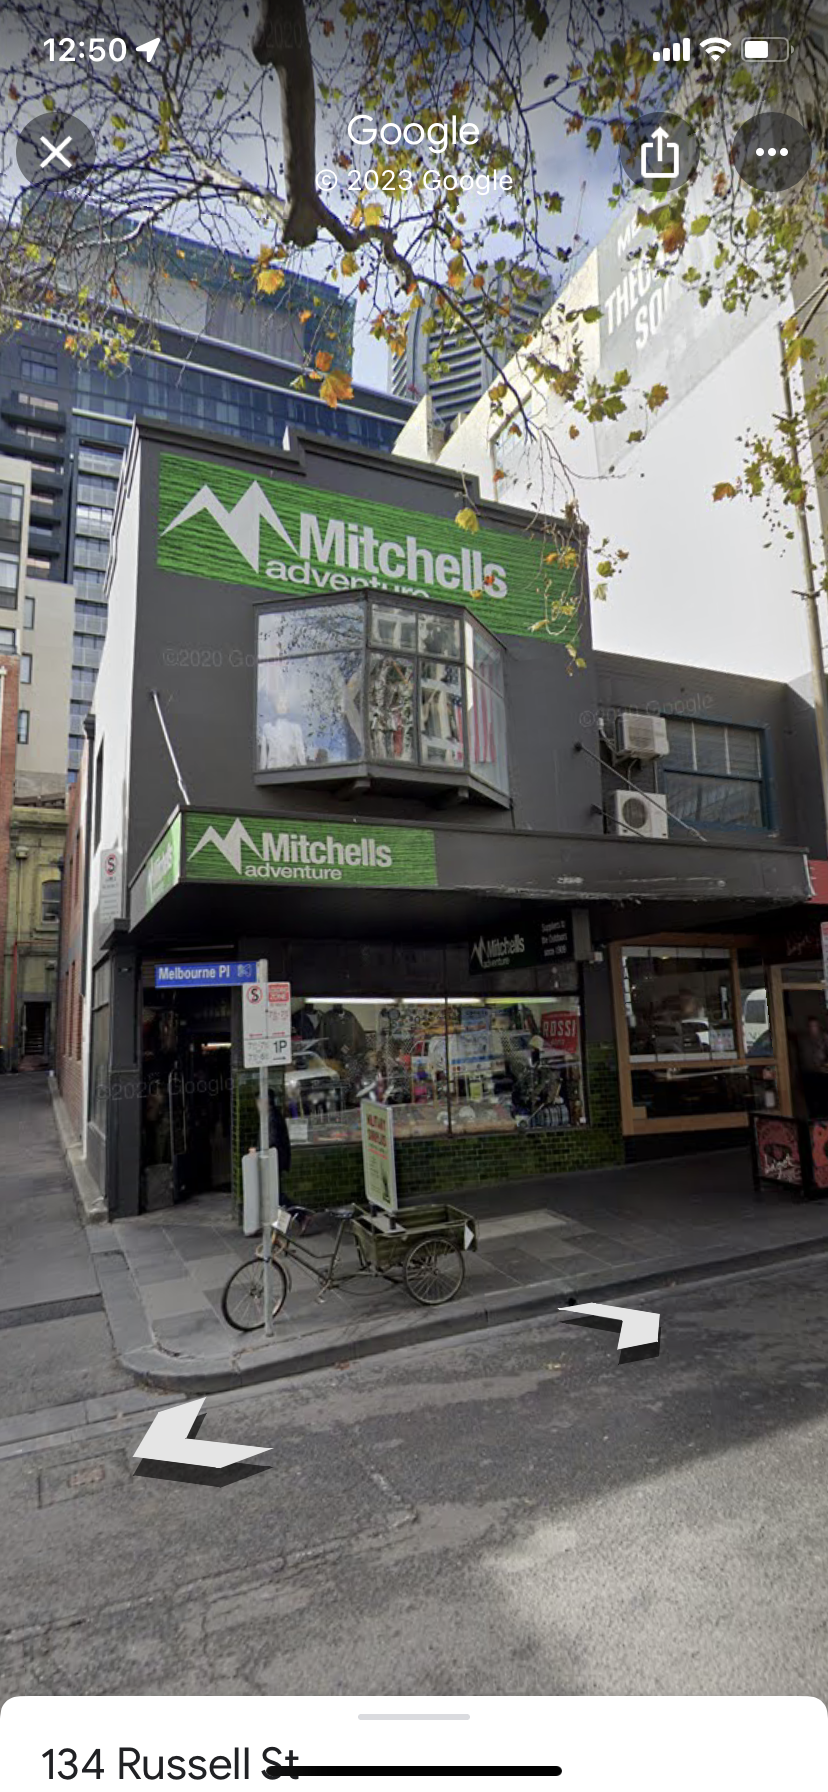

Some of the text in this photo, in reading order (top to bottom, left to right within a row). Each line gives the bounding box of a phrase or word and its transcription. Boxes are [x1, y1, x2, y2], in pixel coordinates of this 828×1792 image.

[299, 514, 508, 599] Mitchells
[262, 832, 393, 868] Mitchells
[245, 862, 342, 880] adventure
[488, 933, 525, 959] Mitchells
[158, 964, 230, 980] Melbourne Pl
[542, 1019, 576, 1037] ROSSI
[273, 1040, 287, 1053] 1P
